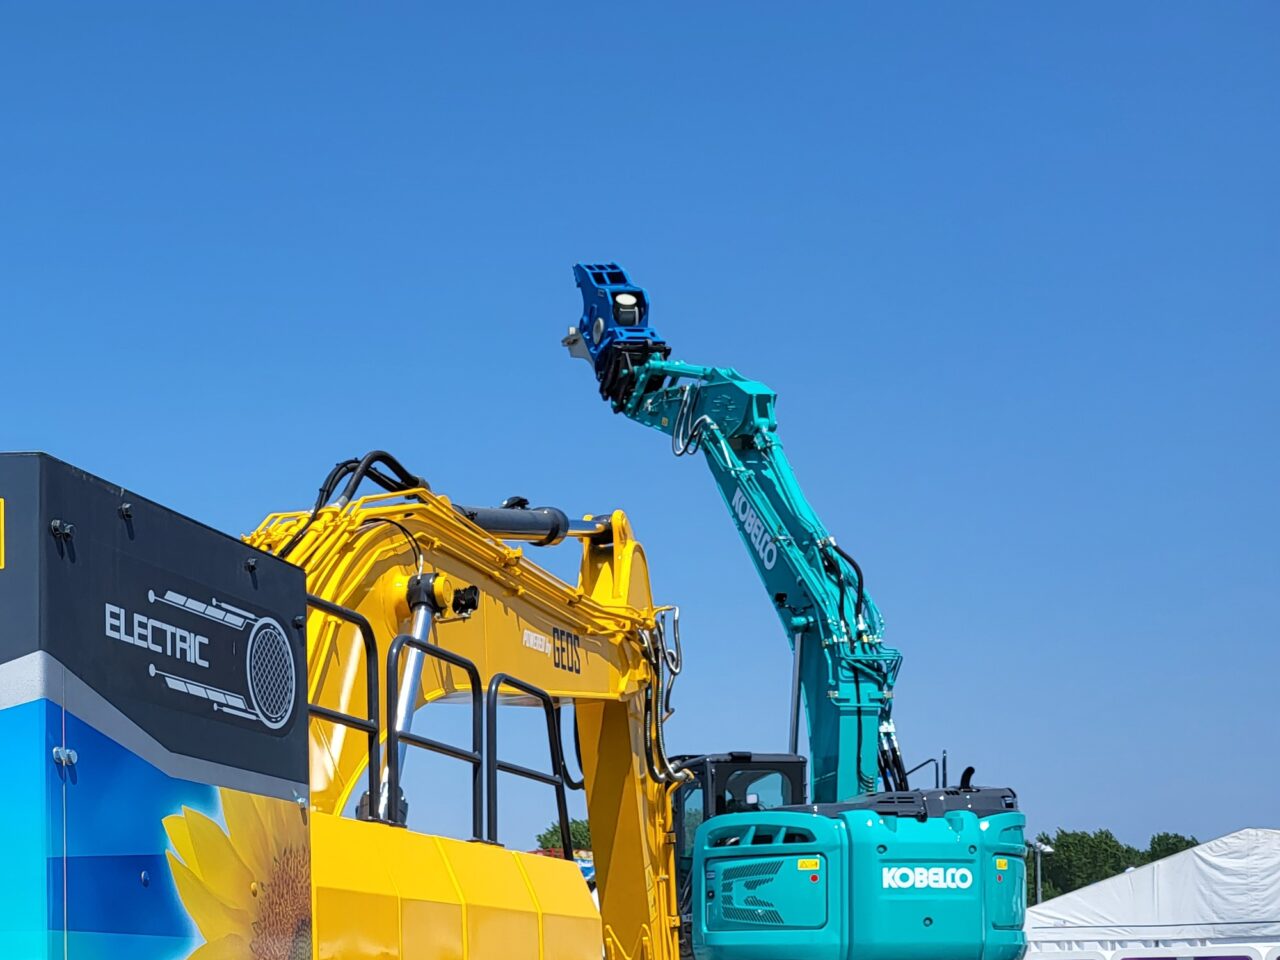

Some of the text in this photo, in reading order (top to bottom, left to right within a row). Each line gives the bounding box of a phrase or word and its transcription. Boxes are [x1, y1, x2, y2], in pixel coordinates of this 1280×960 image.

[731, 487, 777, 570] KOBELCO
[105, 602, 210, 668] ELECTRIC
[553, 627, 581, 674] GEOS
[882, 867, 973, 889] KOBELCO
